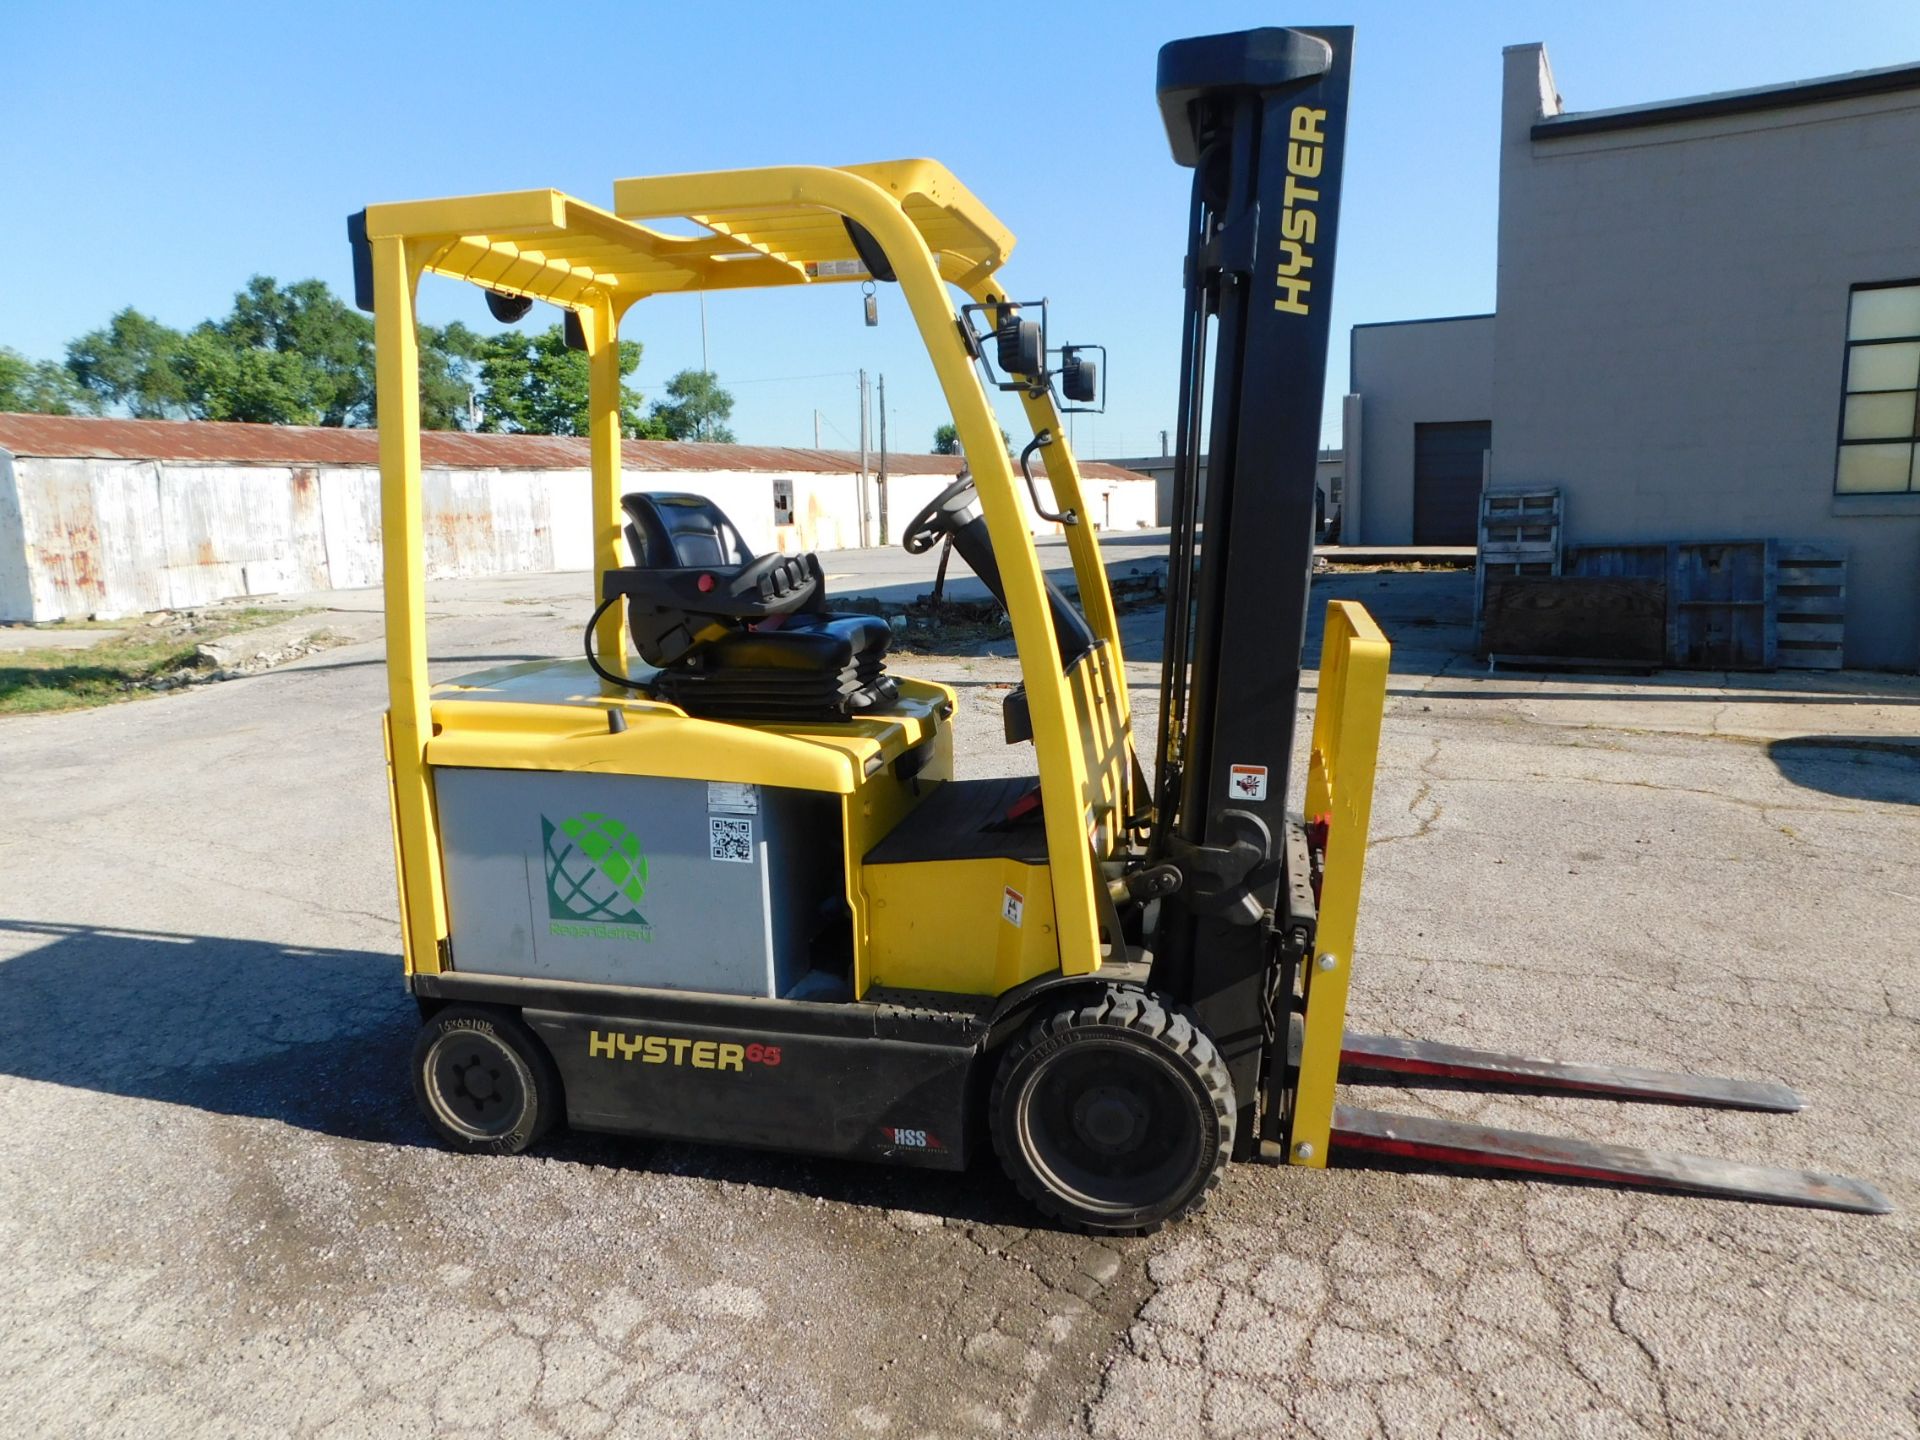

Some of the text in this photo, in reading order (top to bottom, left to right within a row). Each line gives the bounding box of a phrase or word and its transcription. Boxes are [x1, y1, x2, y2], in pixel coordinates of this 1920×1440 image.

[1274, 106, 1327, 315] HYSTER
[589, 1030, 781, 1072] HYSTER 65
[894, 1128, 927, 1147] HSS
